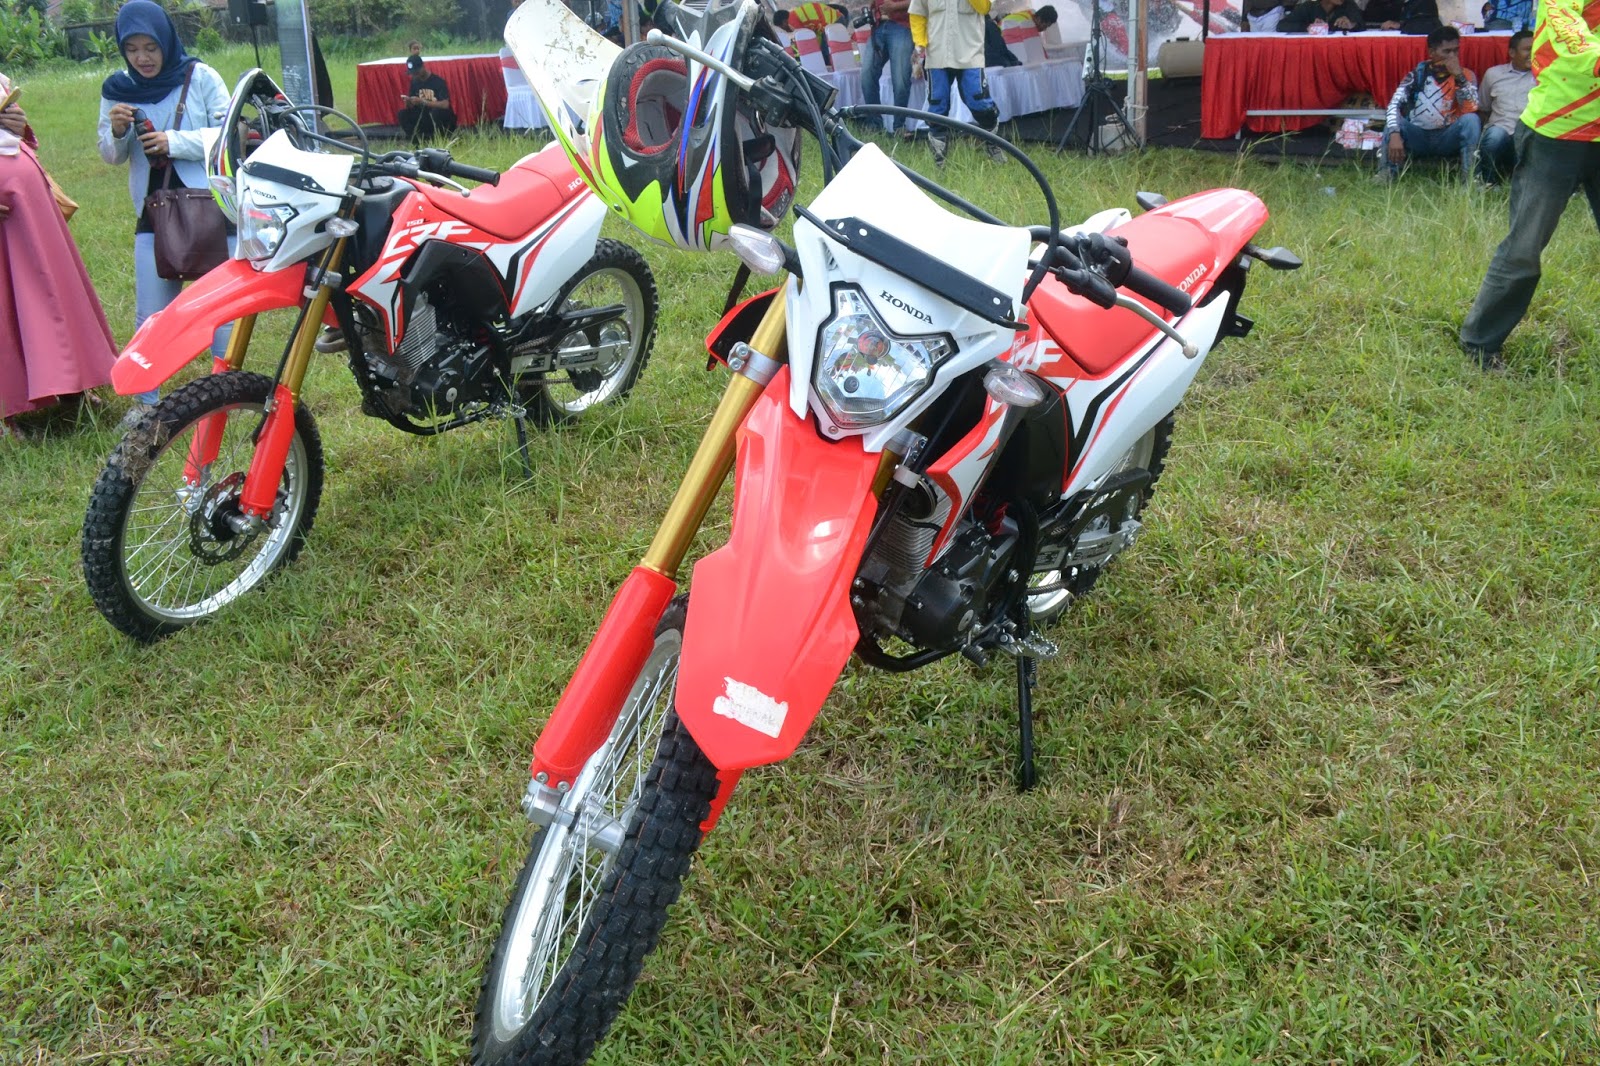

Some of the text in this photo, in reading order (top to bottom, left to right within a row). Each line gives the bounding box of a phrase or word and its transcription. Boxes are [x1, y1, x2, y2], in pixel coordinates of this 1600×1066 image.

[253, 189, 277, 200] HONDA
[382, 220, 473, 260] CRF
[1176, 263, 1207, 292] ONDA
[879, 290, 934, 325] HONDA
[1007, 339, 1063, 372] RF
